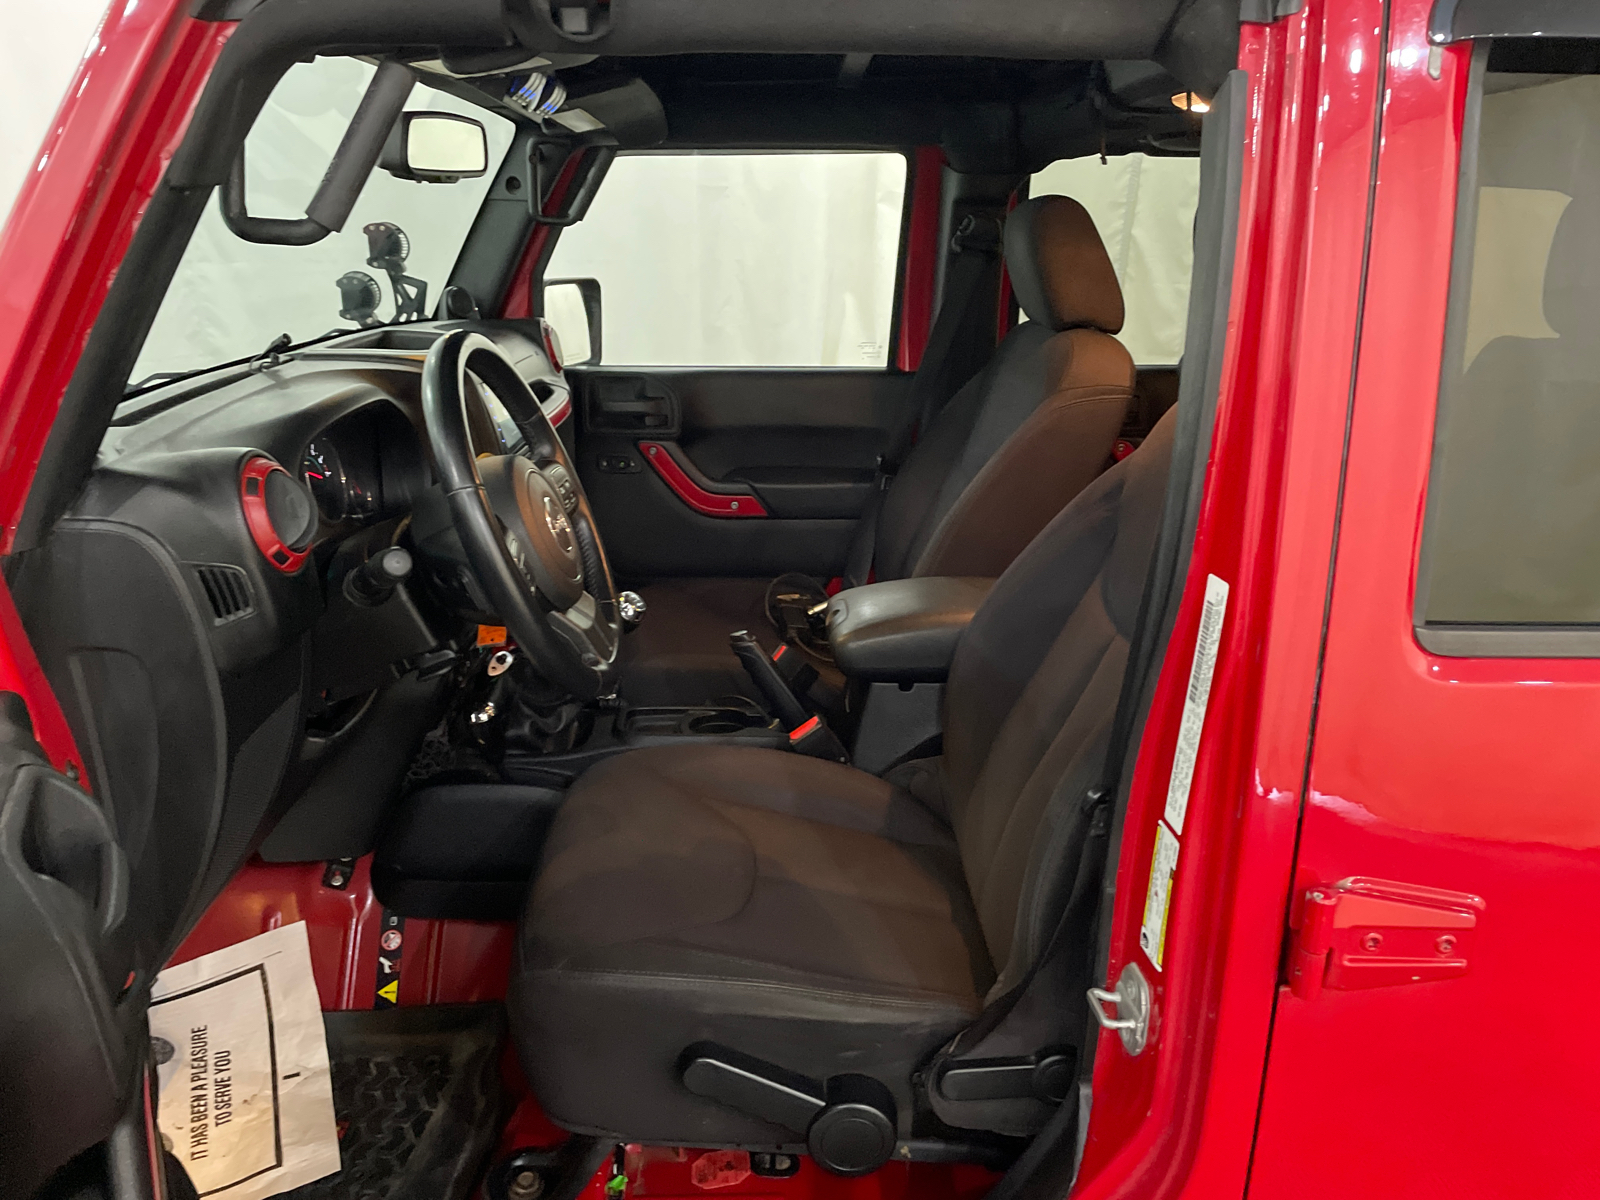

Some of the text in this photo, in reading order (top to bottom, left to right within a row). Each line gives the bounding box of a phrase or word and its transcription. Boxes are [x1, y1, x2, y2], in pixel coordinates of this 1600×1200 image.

[190, 1025, 209, 1161] IT HAS BEEN A PLEASURE
[214, 1050, 233, 1127] TO SERVE YOU
